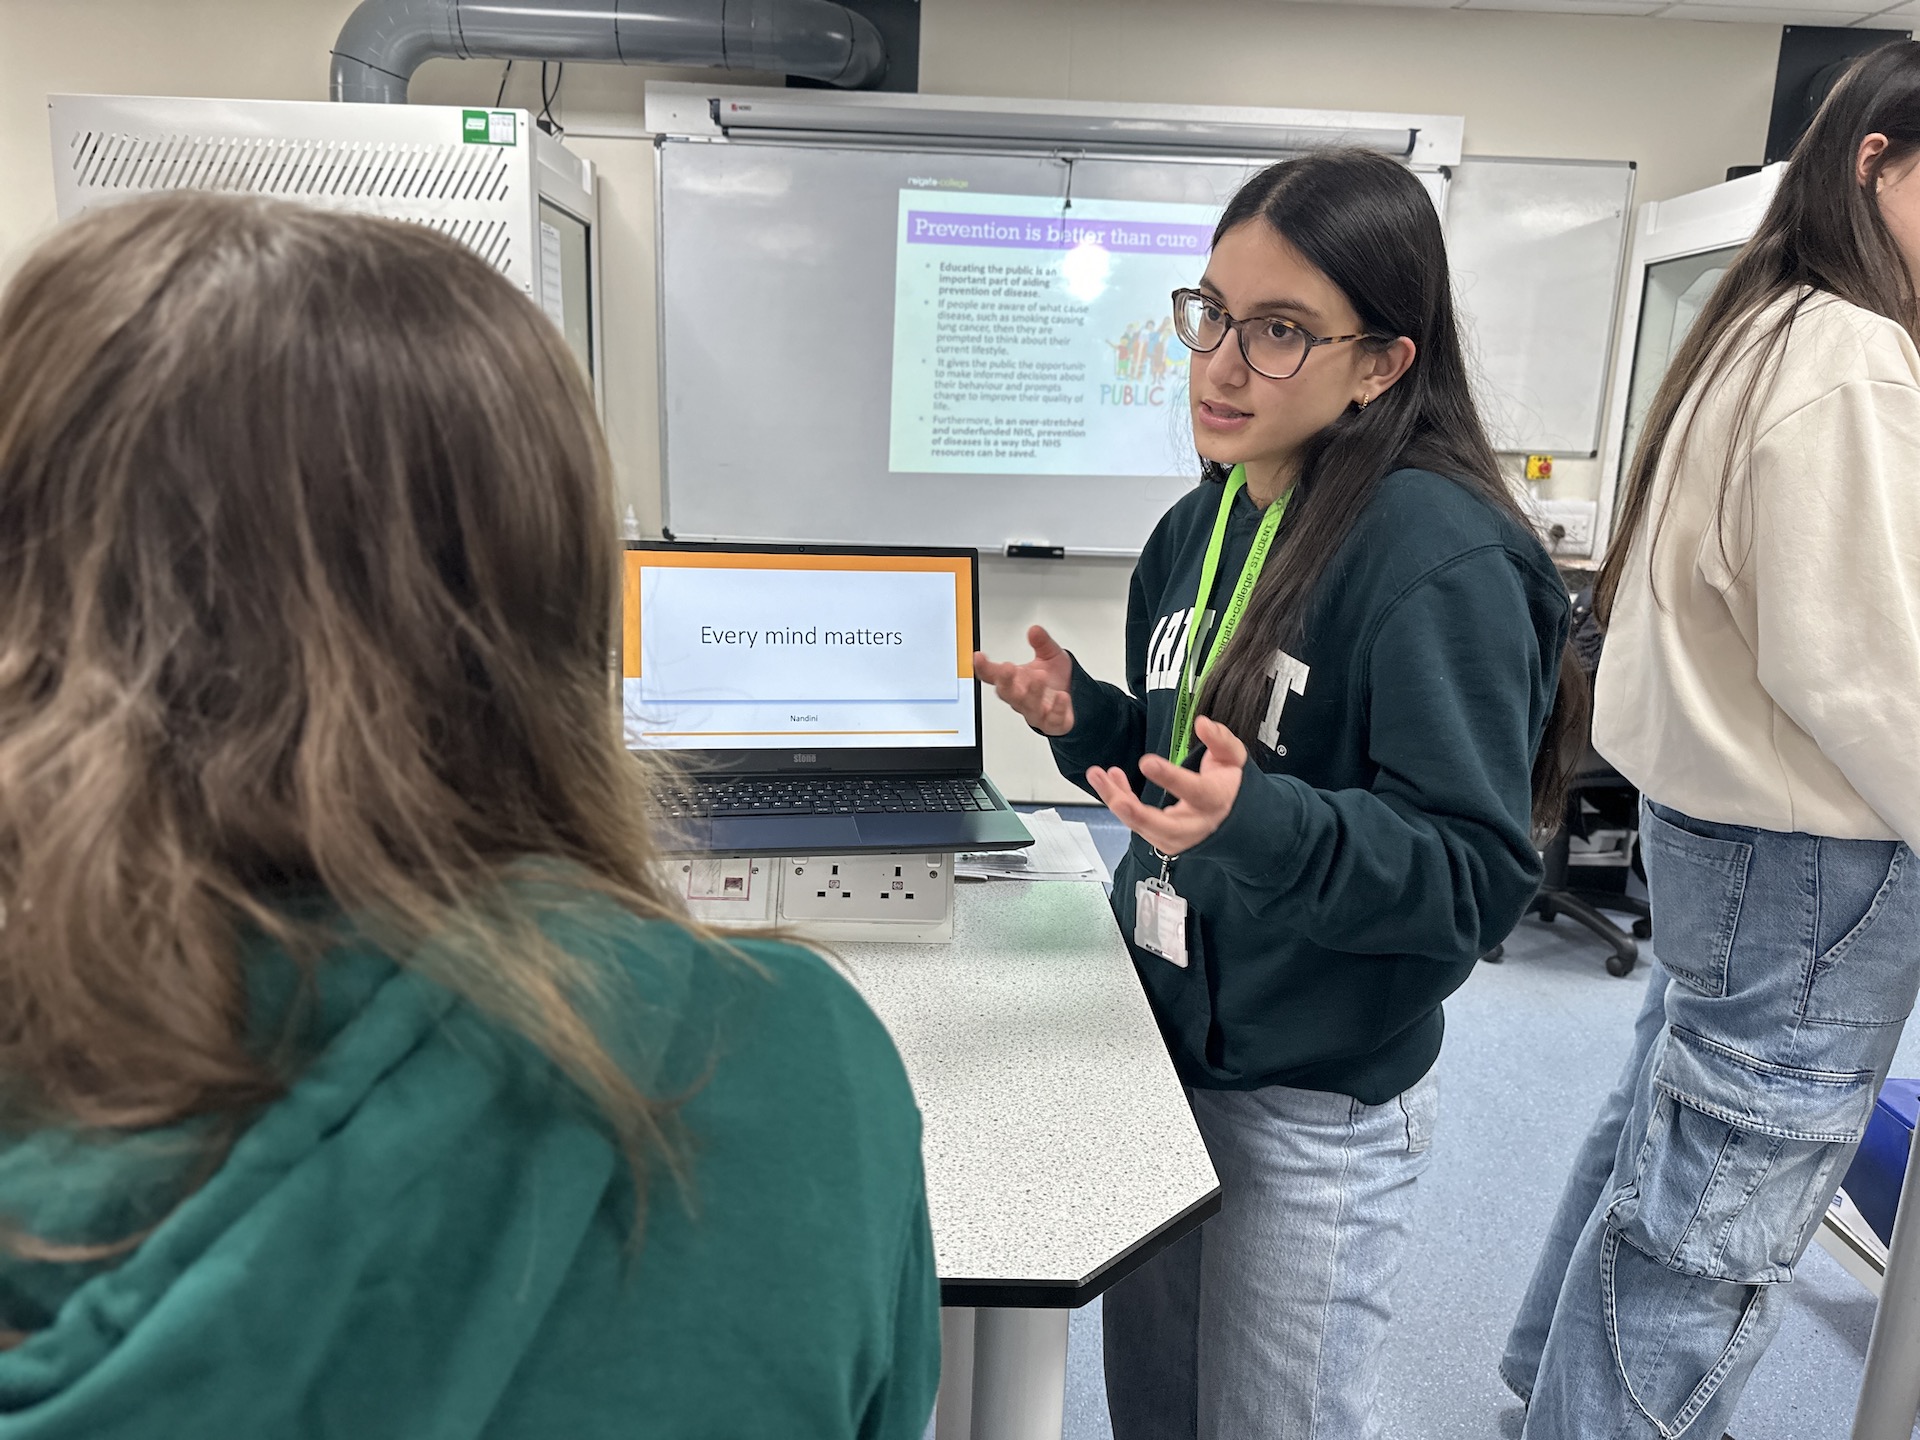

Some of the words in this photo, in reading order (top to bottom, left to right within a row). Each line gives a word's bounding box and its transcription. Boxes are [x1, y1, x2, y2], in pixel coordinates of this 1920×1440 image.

[915, 218, 1020, 240] Prevention
[1025, 223, 1041, 241] is
[1046, 225, 1106, 245] better
[1111, 228, 1151, 246] than
[1156, 233, 1198, 248] cure
[940, 262, 986, 275] Educating
[987, 265, 1004, 274] the
[1005, 265, 1034, 276] public
[1036, 266, 1043, 275] is
[1045, 268, 1057, 276] an
[939, 275, 986, 285] important
[988, 277, 1008, 286] part
[1010, 277, 1020, 286] of
[1022, 278, 1050, 289] aiding
[938, 286, 990, 296] prevention
[992, 287, 1002, 296] of
[1004, 288, 1041, 298] disease.
[947, 300, 978, 310] people
[980, 302, 995, 310] are
[998, 302, 1025, 311] aware
[1027, 303, 1038, 312] of
[1039, 304, 1062, 313] what
[1063, 305, 1089, 313] cause
[976, 312, 997, 322] such
[1000, 314, 1009, 322] as
[1011, 313, 1049, 325] smoking
[1050, 315, 1085, 326] causing
[937, 322, 957, 333] lung
[993, 324, 1014, 333] then
[1016, 325, 1036, 335] they
[936, 334, 982, 344] prompted
[984, 335, 994, 344] to
[996, 335, 1018, 344] think
[1021, 336, 1047, 345] about
[1049, 337, 1071, 346] their
[936, 345, 970, 354] current
[938, 358, 945, 366] It
[946, 358, 970, 368] gives
[972, 359, 987, 368] the
[989, 359, 1017, 369] public
[1018, 360, 1034, 369] the
[935, 369, 945, 378] to
[947, 369, 971, 378] make
[973, 370, 1014, 380] informed
[1016, 371, 1057, 381] decisions
[1059, 372, 1085, 381] about
[934, 380, 956, 389] their
[958, 381, 1003, 390] behaviour
[1005, 382, 1022, 391] and
[1024, 383, 1062, 393] prompts
[933, 391, 966, 402] change
[968, 392, 978, 401] to
[980, 393, 1017, 403] improve
[1019, 393, 1040, 402] their
[1042, 394, 1073, 404] quality
[1074, 394, 1084, 403] of
[1100, 384, 1165, 406] PUBLIC
[994, 416, 1004, 426] in
[1005, 418, 1017, 426] an
[932, 426, 950, 435] and
[952, 426, 1011, 436] underfunded
[1037, 429, 1086, 439] prevention
[931, 436, 942, 446] of
[943, 437, 982, 447] diseases
[984, 438, 991, 446] is
[1001, 440, 1019, 449] way
[1021, 438, 1040, 447] that
[1042, 439, 1062, 448] NHS
[931, 448, 975, 457] resources
[995, 449, 1006, 457] be
[1250, 523, 1273, 569] STUDENT
[701, 626, 758, 648] Every
[765, 626, 817, 645] mind
[825, 628, 903, 645] matters
[793, 753, 817, 763] stone
